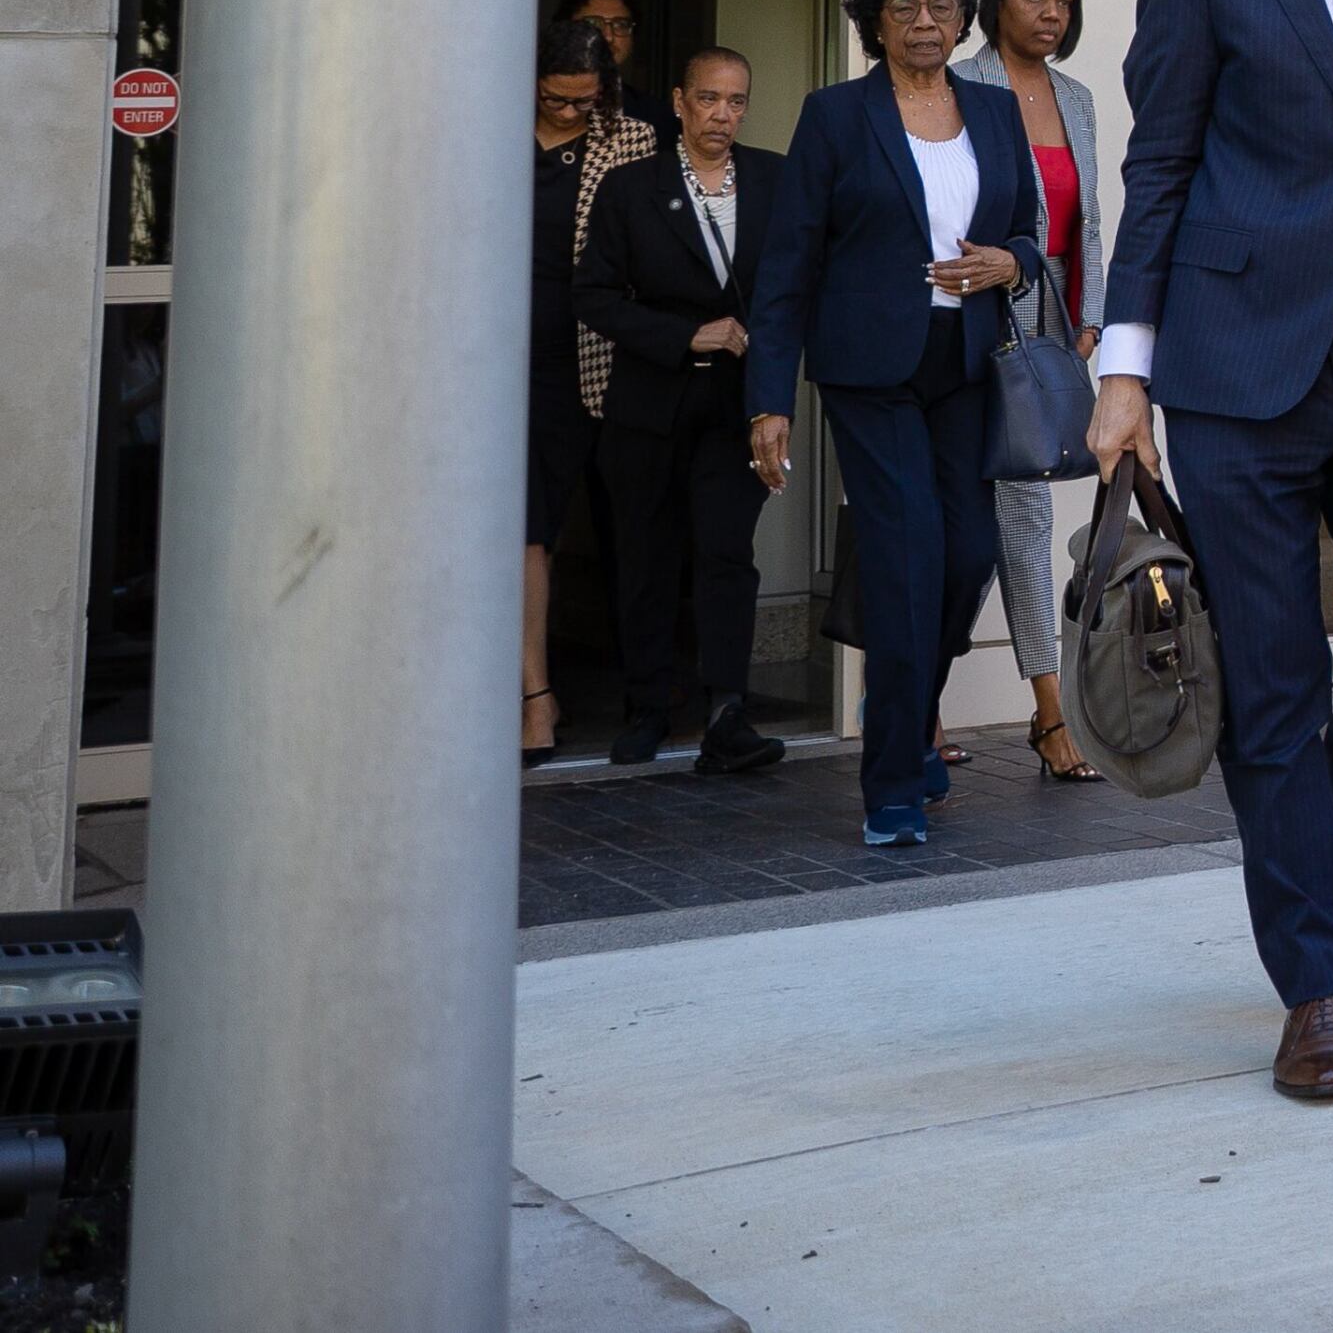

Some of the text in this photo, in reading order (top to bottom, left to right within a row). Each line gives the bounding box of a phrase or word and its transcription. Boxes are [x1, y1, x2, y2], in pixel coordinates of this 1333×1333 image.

[121, 82, 169, 94] DO NOT
[124, 111, 164, 123] ENTER
